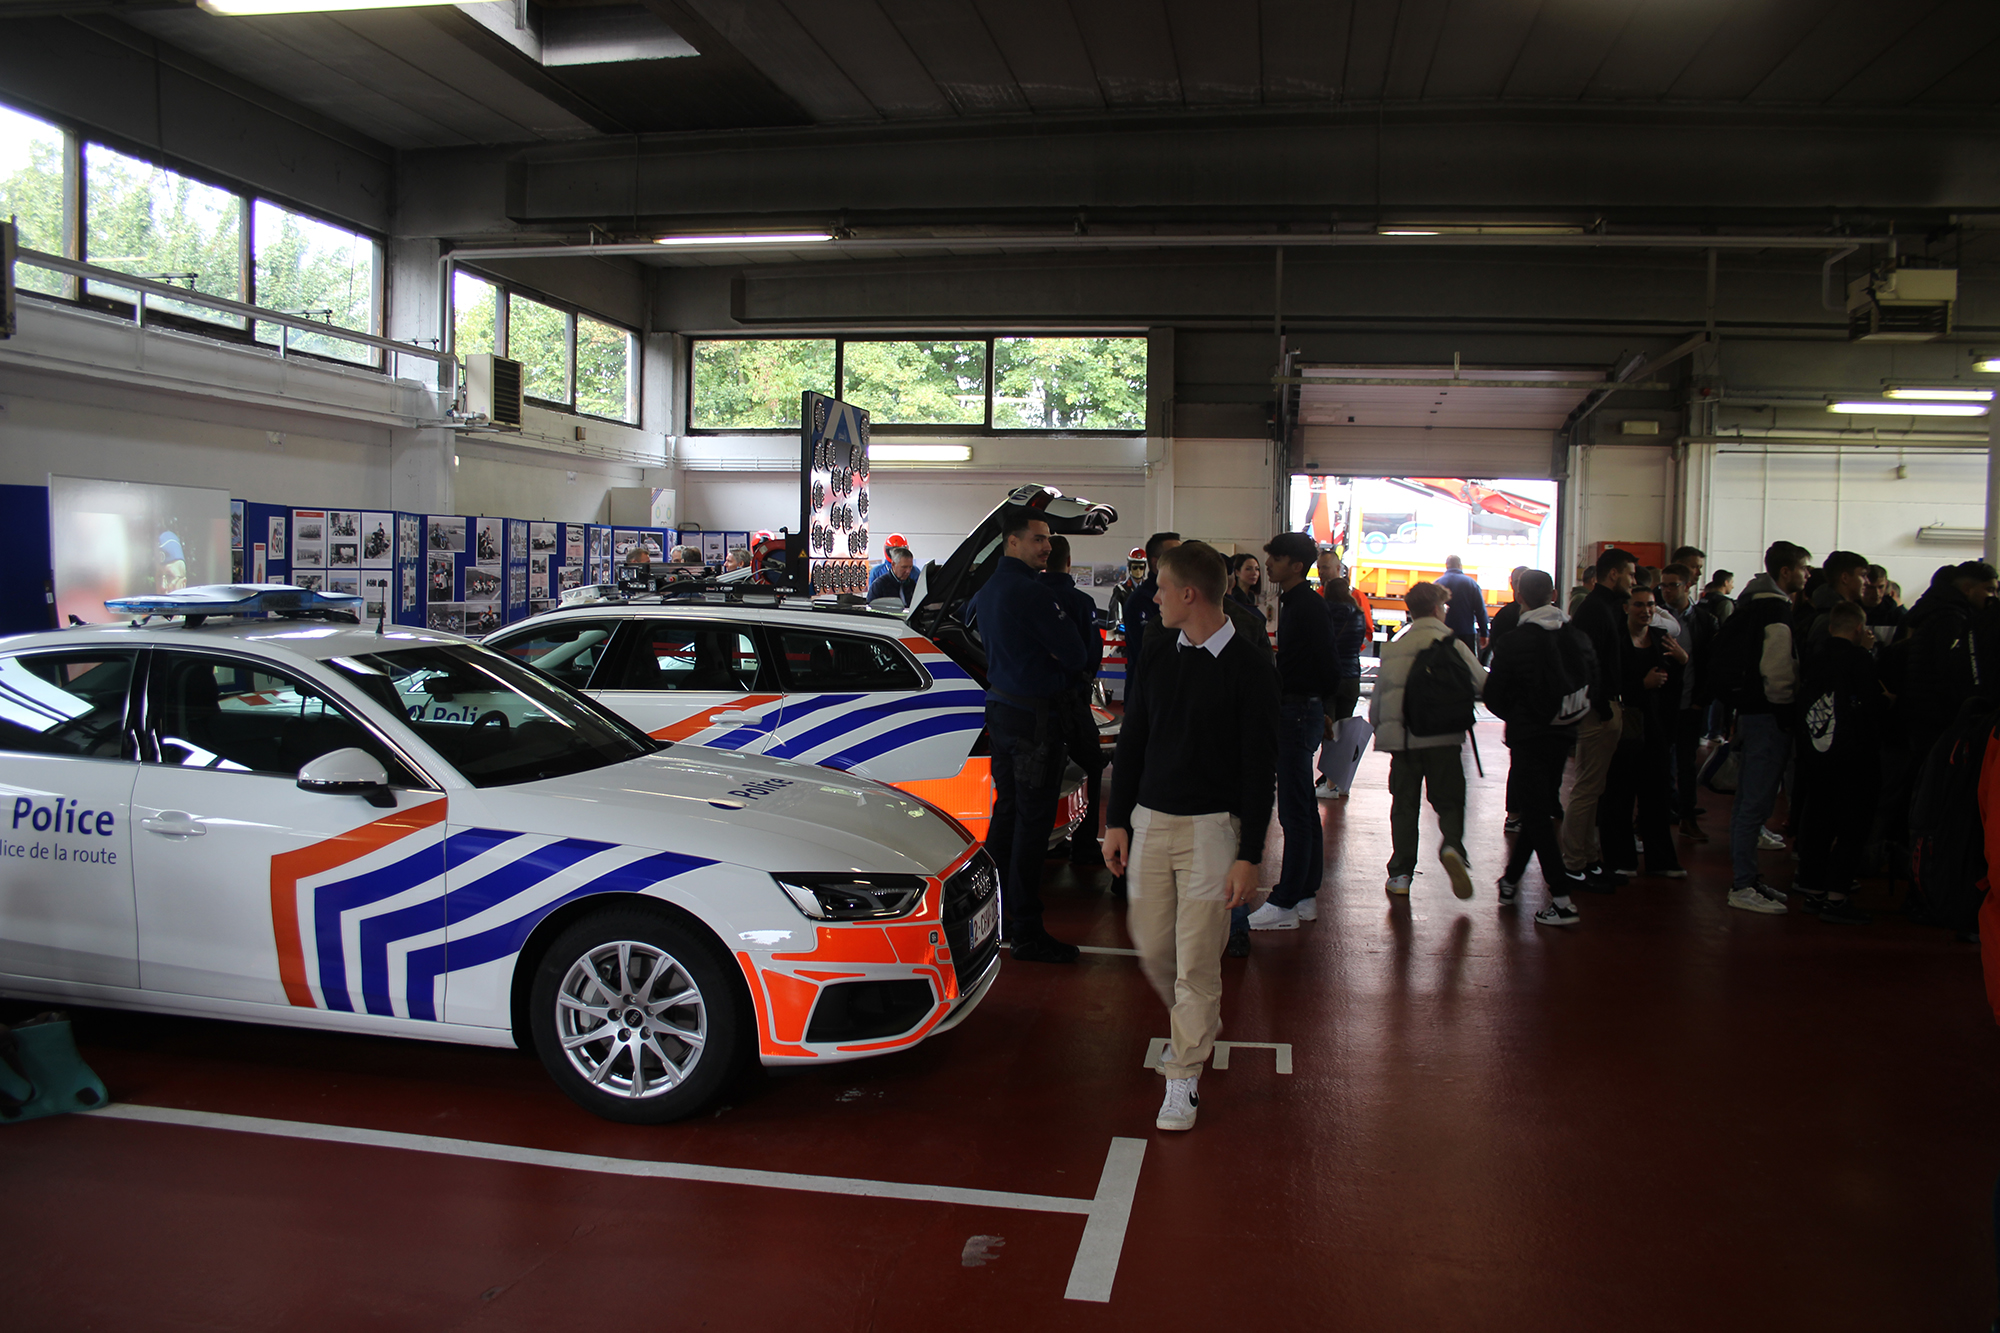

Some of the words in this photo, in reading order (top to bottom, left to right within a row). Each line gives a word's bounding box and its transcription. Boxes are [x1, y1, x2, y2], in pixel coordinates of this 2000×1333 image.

[727, 778, 794, 800] Police
[12, 797, 115, 836] Police
[30, 841, 49, 860] de
[54, 843, 67, 861] la
[73, 848, 117, 865] route
